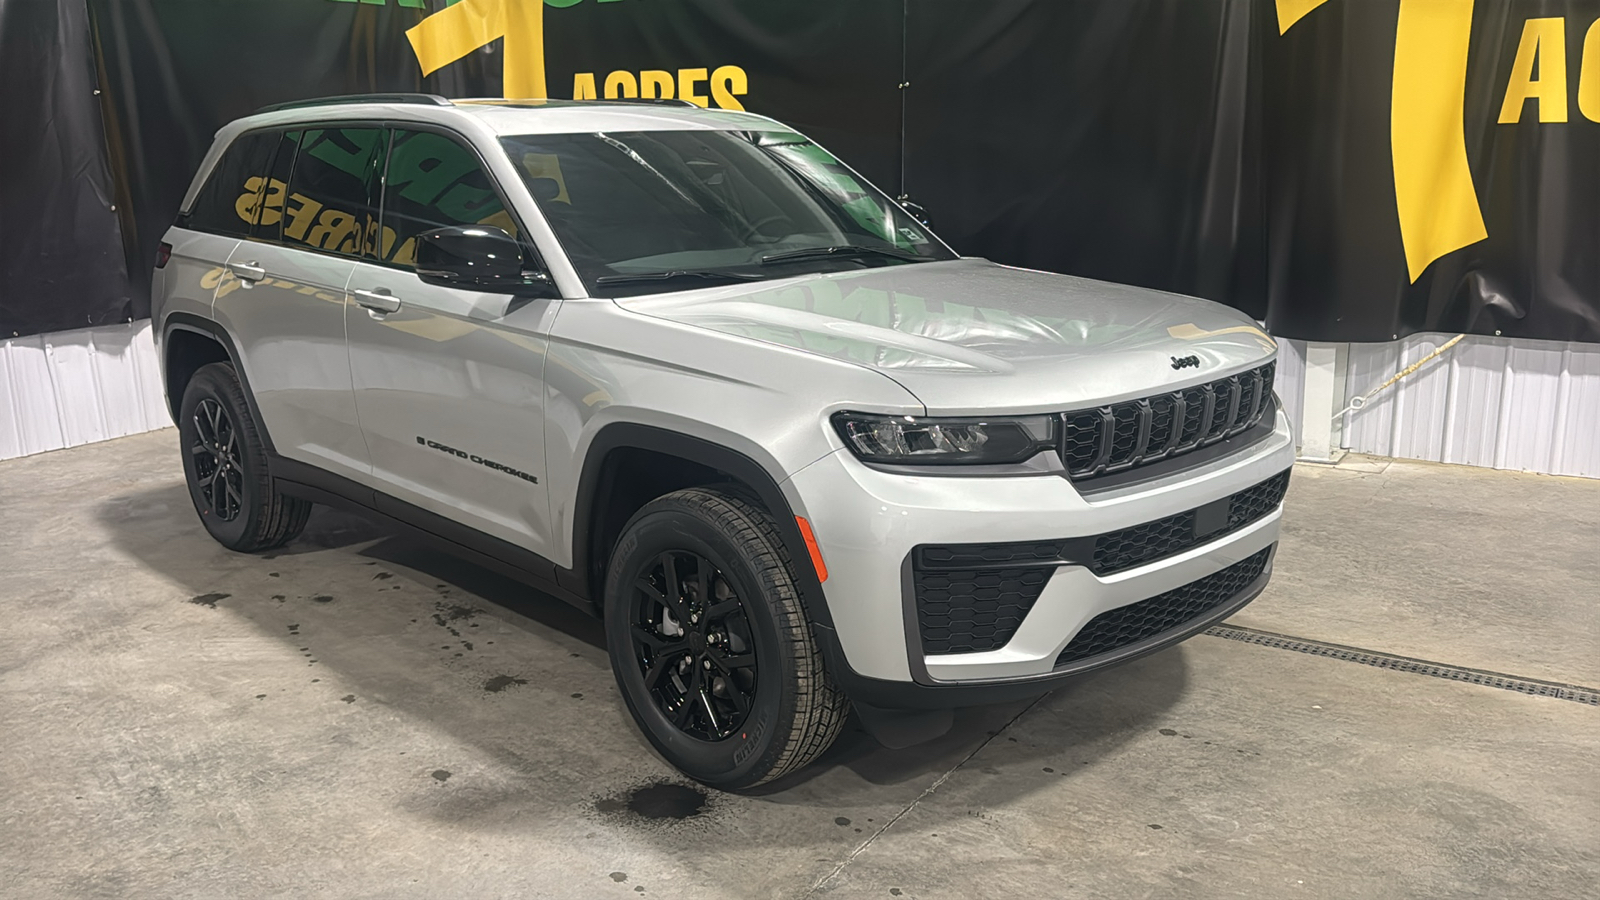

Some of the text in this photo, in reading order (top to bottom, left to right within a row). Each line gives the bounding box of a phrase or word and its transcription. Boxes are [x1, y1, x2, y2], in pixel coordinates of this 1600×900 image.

[1170, 355, 1200, 370] Jeep
[427, 440, 538, 484] GRAND CHEROKEE
